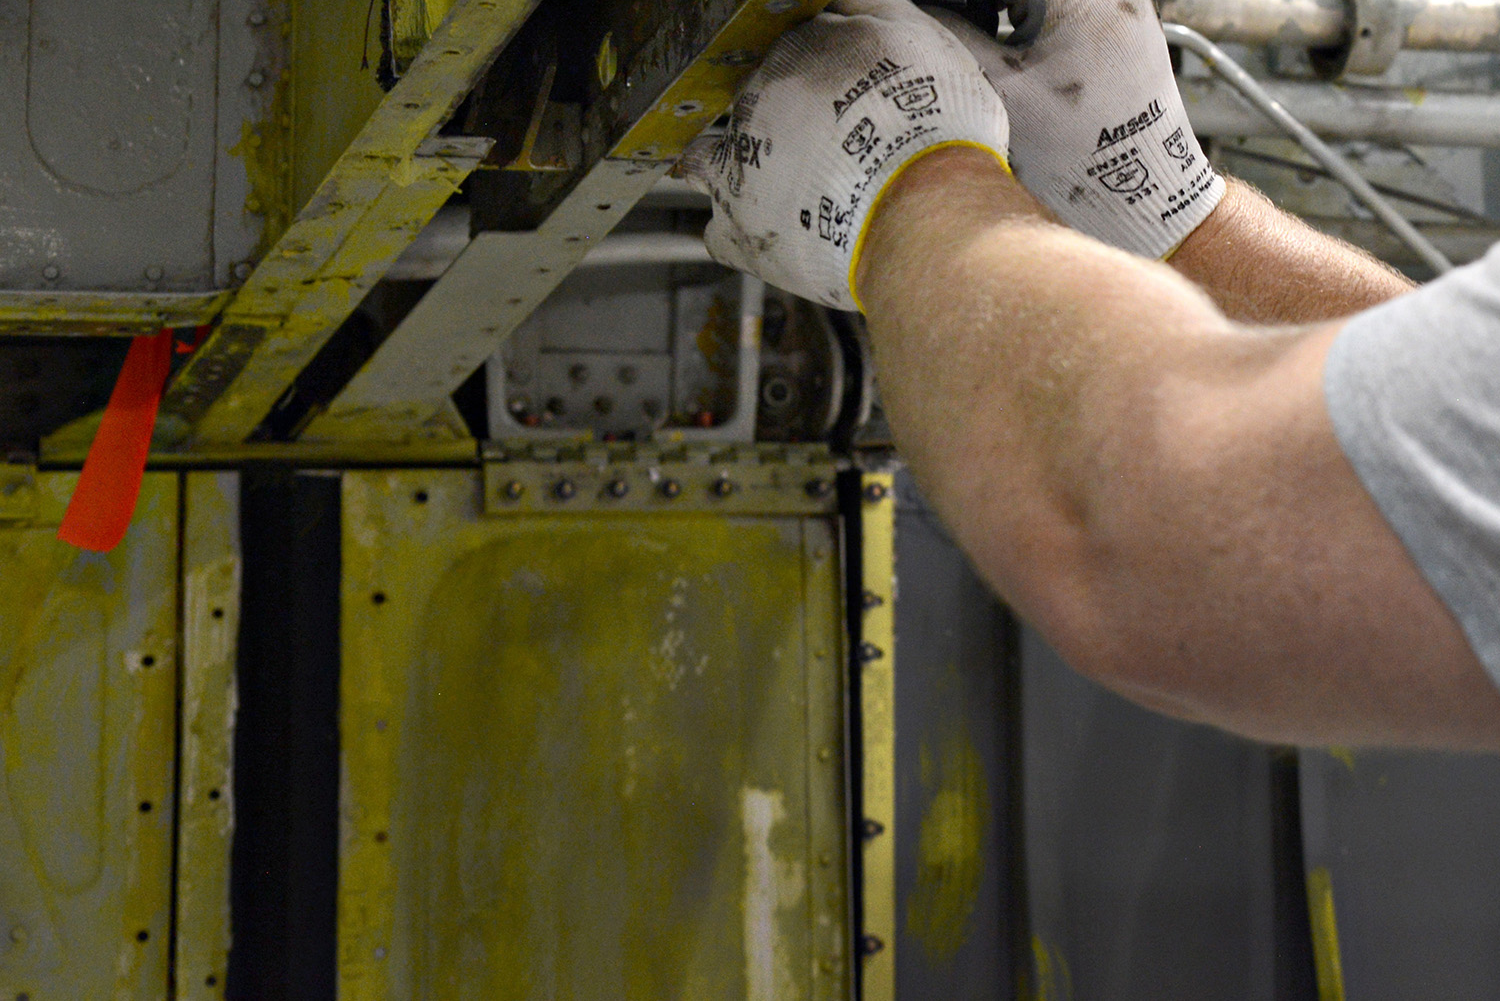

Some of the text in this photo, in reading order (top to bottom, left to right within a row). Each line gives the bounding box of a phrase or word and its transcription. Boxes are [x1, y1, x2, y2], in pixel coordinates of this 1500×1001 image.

[833, 58, 901, 117] Ansell
[1097, 99, 1161, 148] Ansell
[1160, 199, 1192, 222] Made
